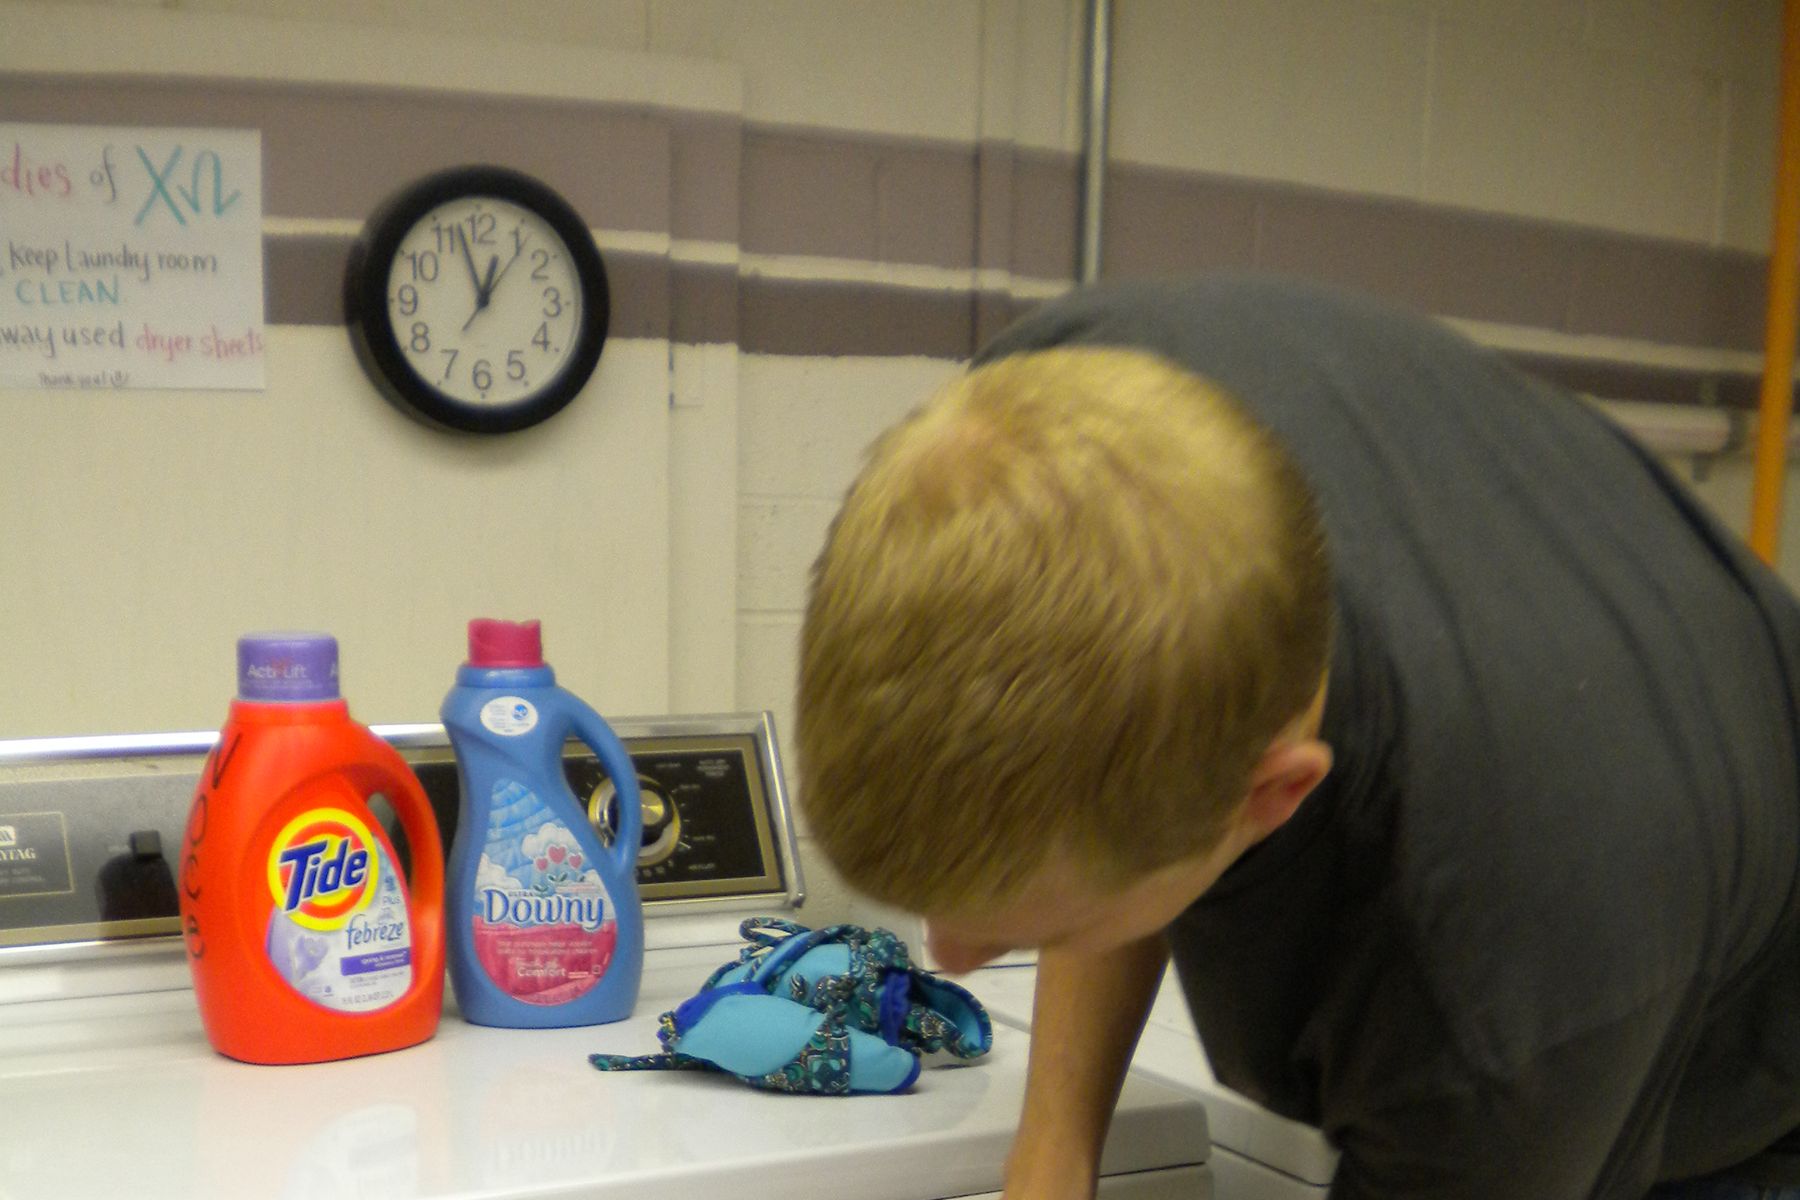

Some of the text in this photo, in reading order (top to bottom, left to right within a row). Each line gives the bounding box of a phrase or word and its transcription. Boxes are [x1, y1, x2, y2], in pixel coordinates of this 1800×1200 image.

[89, 146, 117, 201] of
[433, 223, 455, 254] 11
[465, 212, 497, 246] 12
[510, 226, 521, 256] 1
[157, 251, 218, 272] room
[407, 251, 439, 282] 10
[530, 250, 549, 281] 2
[15, 275, 121, 305] CLEAN
[398, 284, 418, 316] 9
[542, 286, 562, 318] 3
[61, 320, 125, 349] used
[135, 323, 193, 361] dryer
[410, 321, 431, 353] 8
[531, 321, 552, 353] 4
[441, 348, 459, 379] 7
[471, 359, 492, 391] 6
[506, 350, 526, 381] 5
[279, 836, 368, 912] Tide
[481, 887, 605, 931] Downy
[345, 913, 404, 951] febreze
